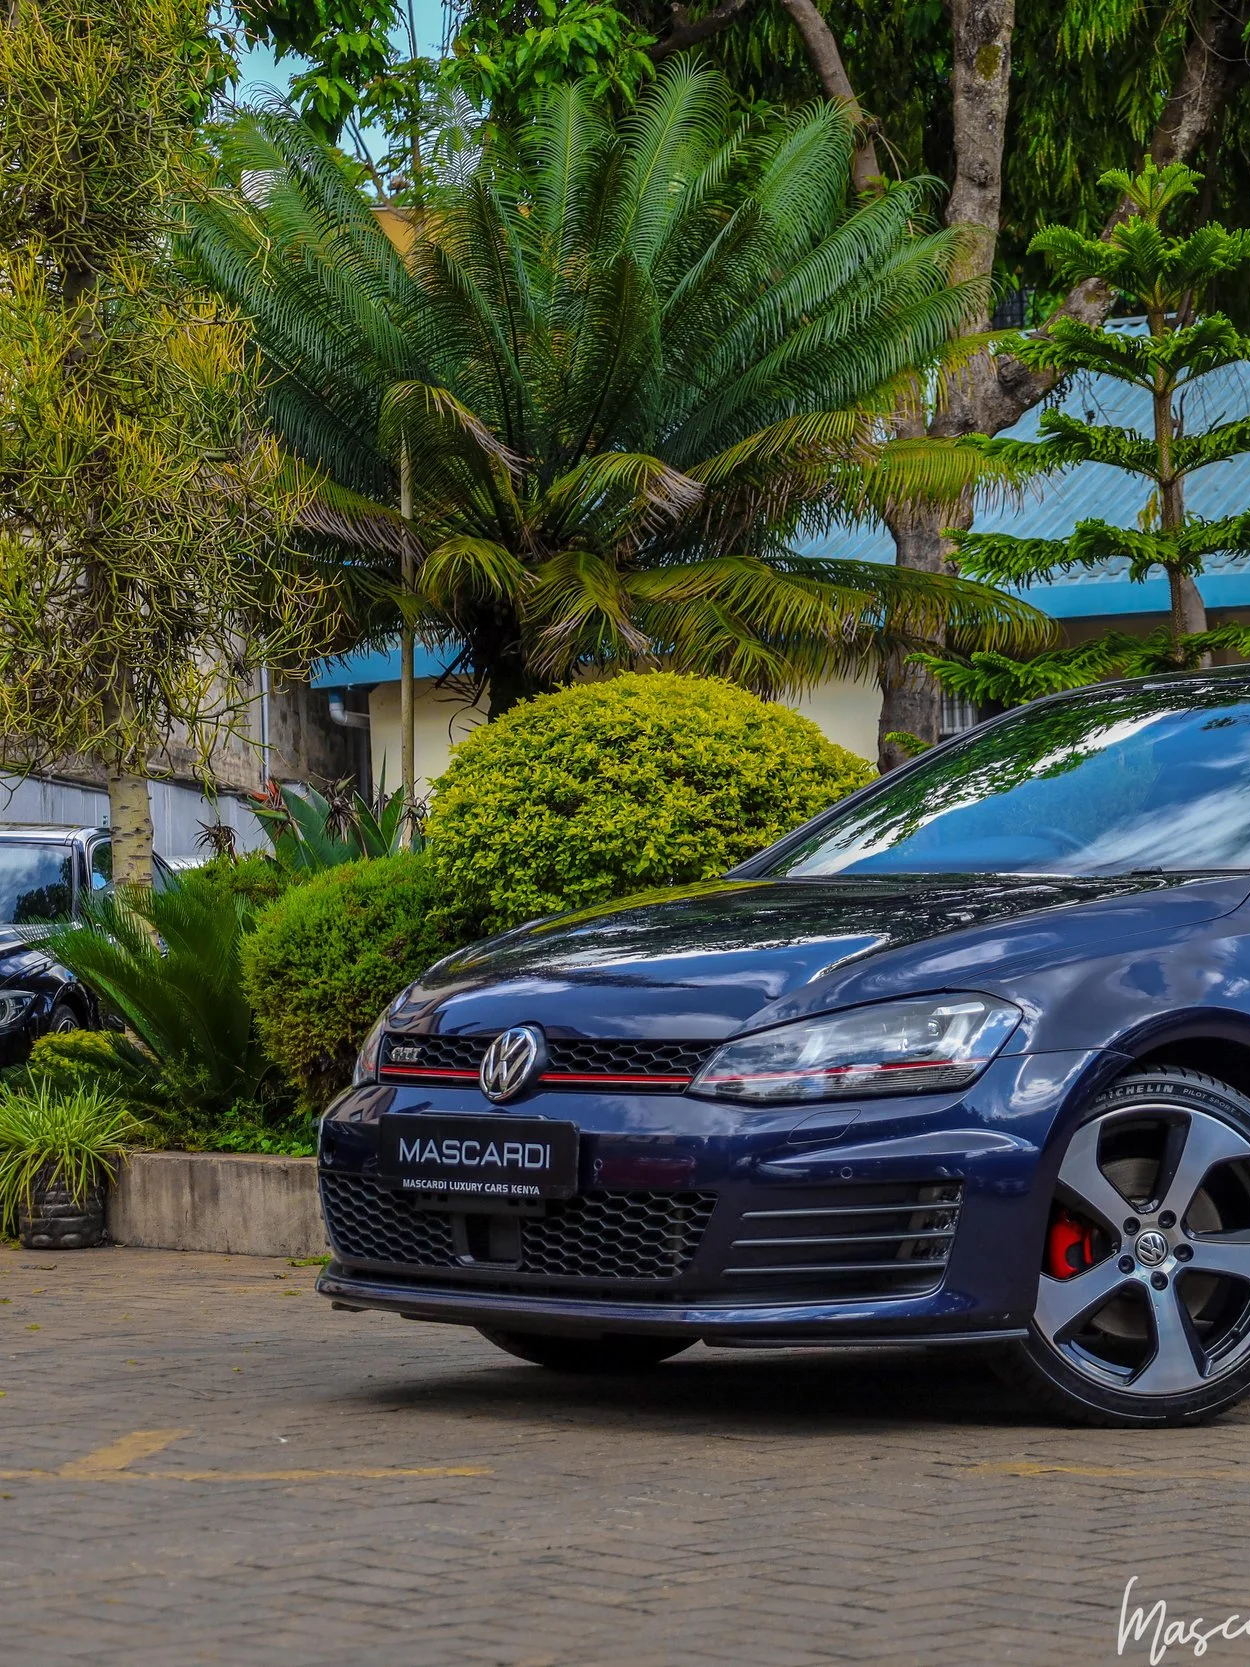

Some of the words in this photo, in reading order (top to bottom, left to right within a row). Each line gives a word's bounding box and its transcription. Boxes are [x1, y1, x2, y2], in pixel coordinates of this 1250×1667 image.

[1095, 1084, 1174, 1103] MICHELIN
[1183, 1088, 1208, 1100] PILOT
[1210, 1096, 1236, 1113] SPORT
[399, 1138, 551, 1169] MASCARDI
[402, 1179, 447, 1190] MASCARDI
[449, 1181, 483, 1192] LUXURY
[485, 1183, 509, 1193] CARS
[511, 1184, 540, 1195] KENYA
